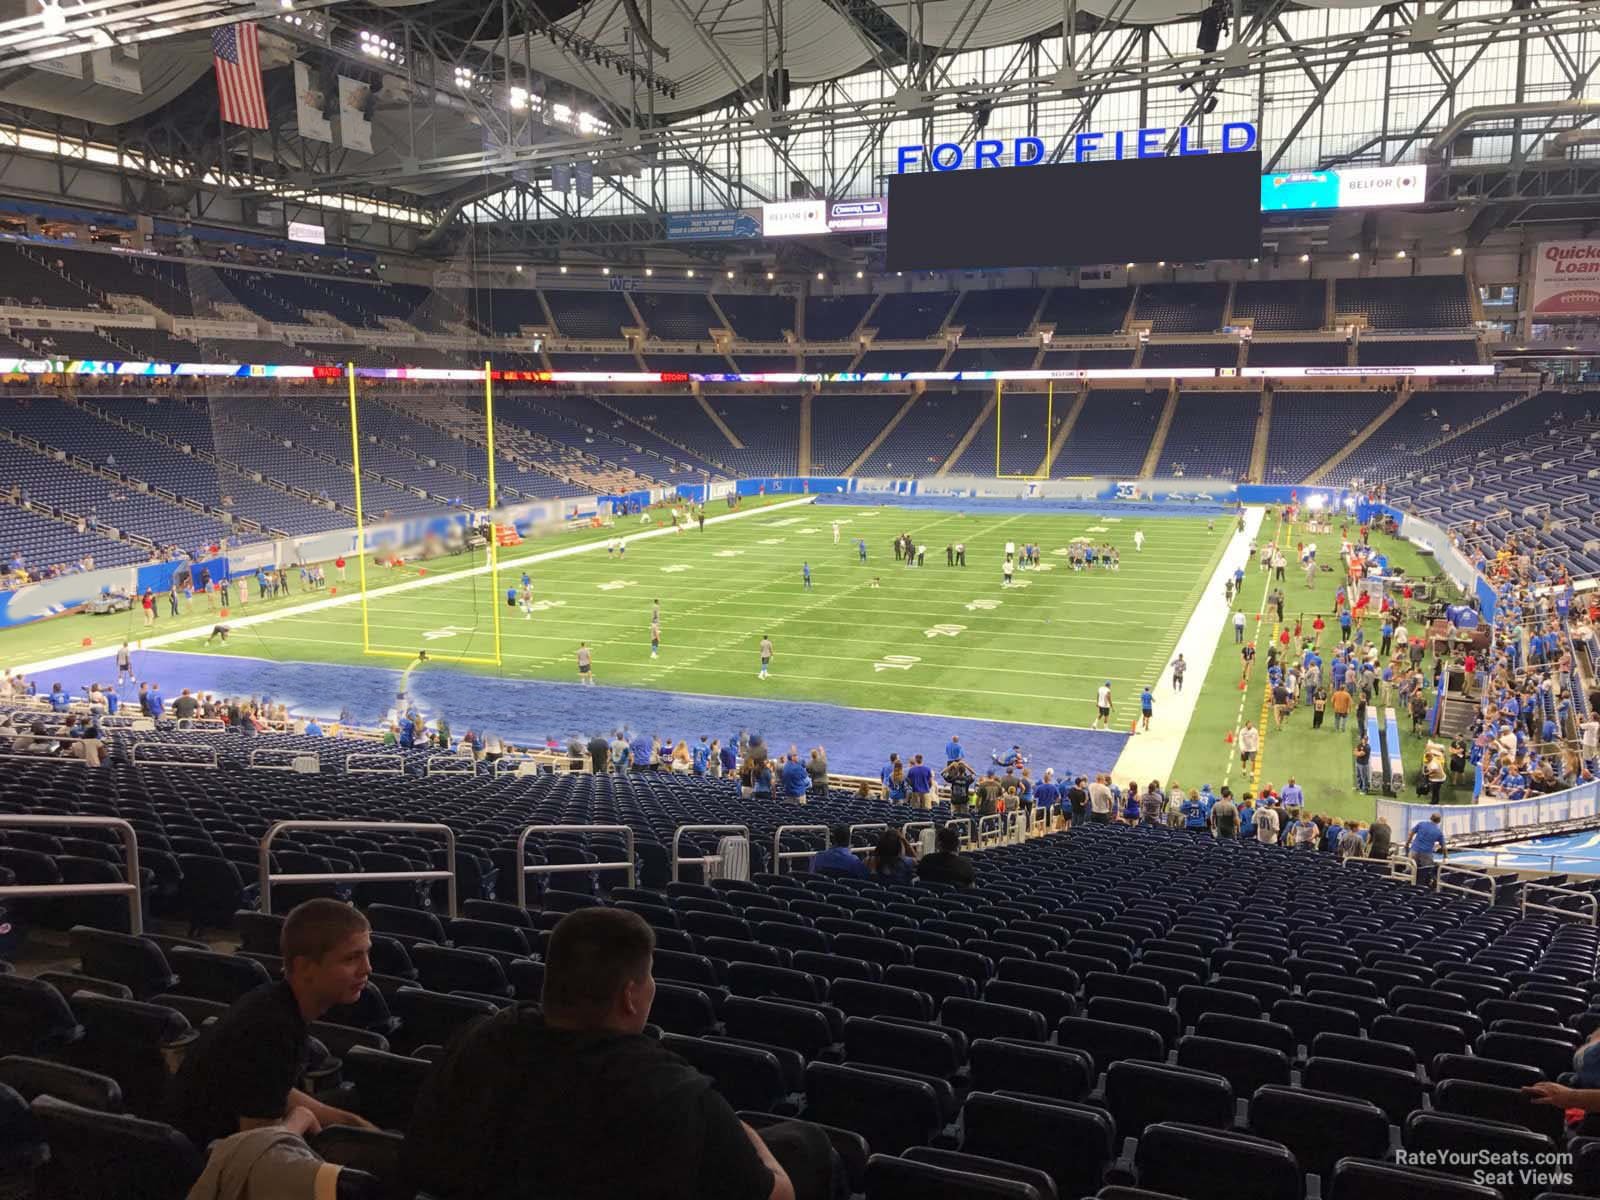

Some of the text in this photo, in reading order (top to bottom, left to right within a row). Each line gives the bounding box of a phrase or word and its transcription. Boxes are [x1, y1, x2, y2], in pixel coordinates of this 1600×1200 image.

[897, 121, 1257, 174] FORD FIELD
[1350, 178, 1392, 190] BELFOR
[1190, 808, 1200, 818] 21
